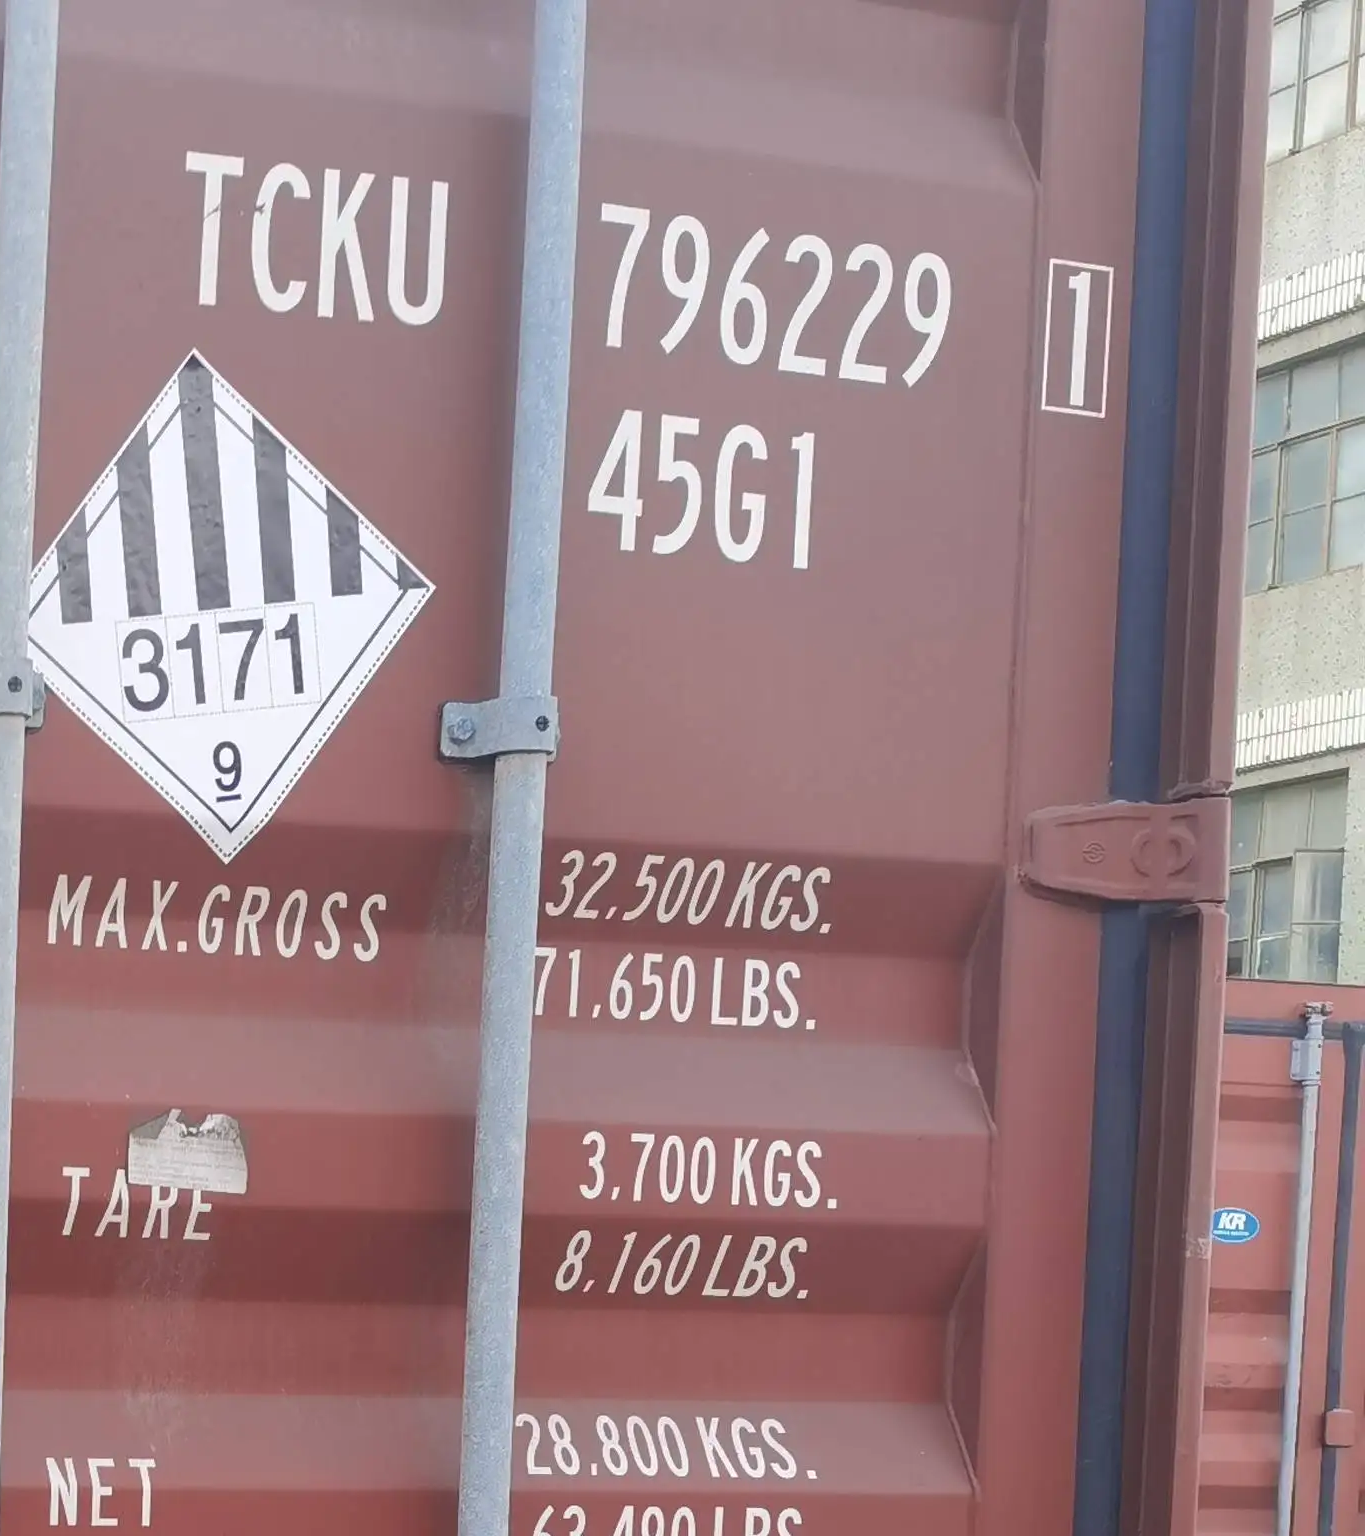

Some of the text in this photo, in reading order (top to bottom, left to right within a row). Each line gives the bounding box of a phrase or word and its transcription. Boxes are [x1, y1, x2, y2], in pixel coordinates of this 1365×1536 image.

[185, 150, 449, 326] TCKU
[600, 202, 952, 389] 796229
[587, 408, 816, 570] 45G1
[122, 613, 305, 712] 3171
[213, 741, 242, 792] 9
[724, 861, 832, 934] KGS.
[710, 957, 817, 1030] LBS.
[62, 1166, 212, 1240] TARE
[731, 1137, 838, 1209] KGS.
[1218, 1212, 1246, 1230] KR
[701, 1234, 809, 1299] LBS.
[696, 1416, 818, 1480] KGS.
[45, 1457, 157, 1527] NET
